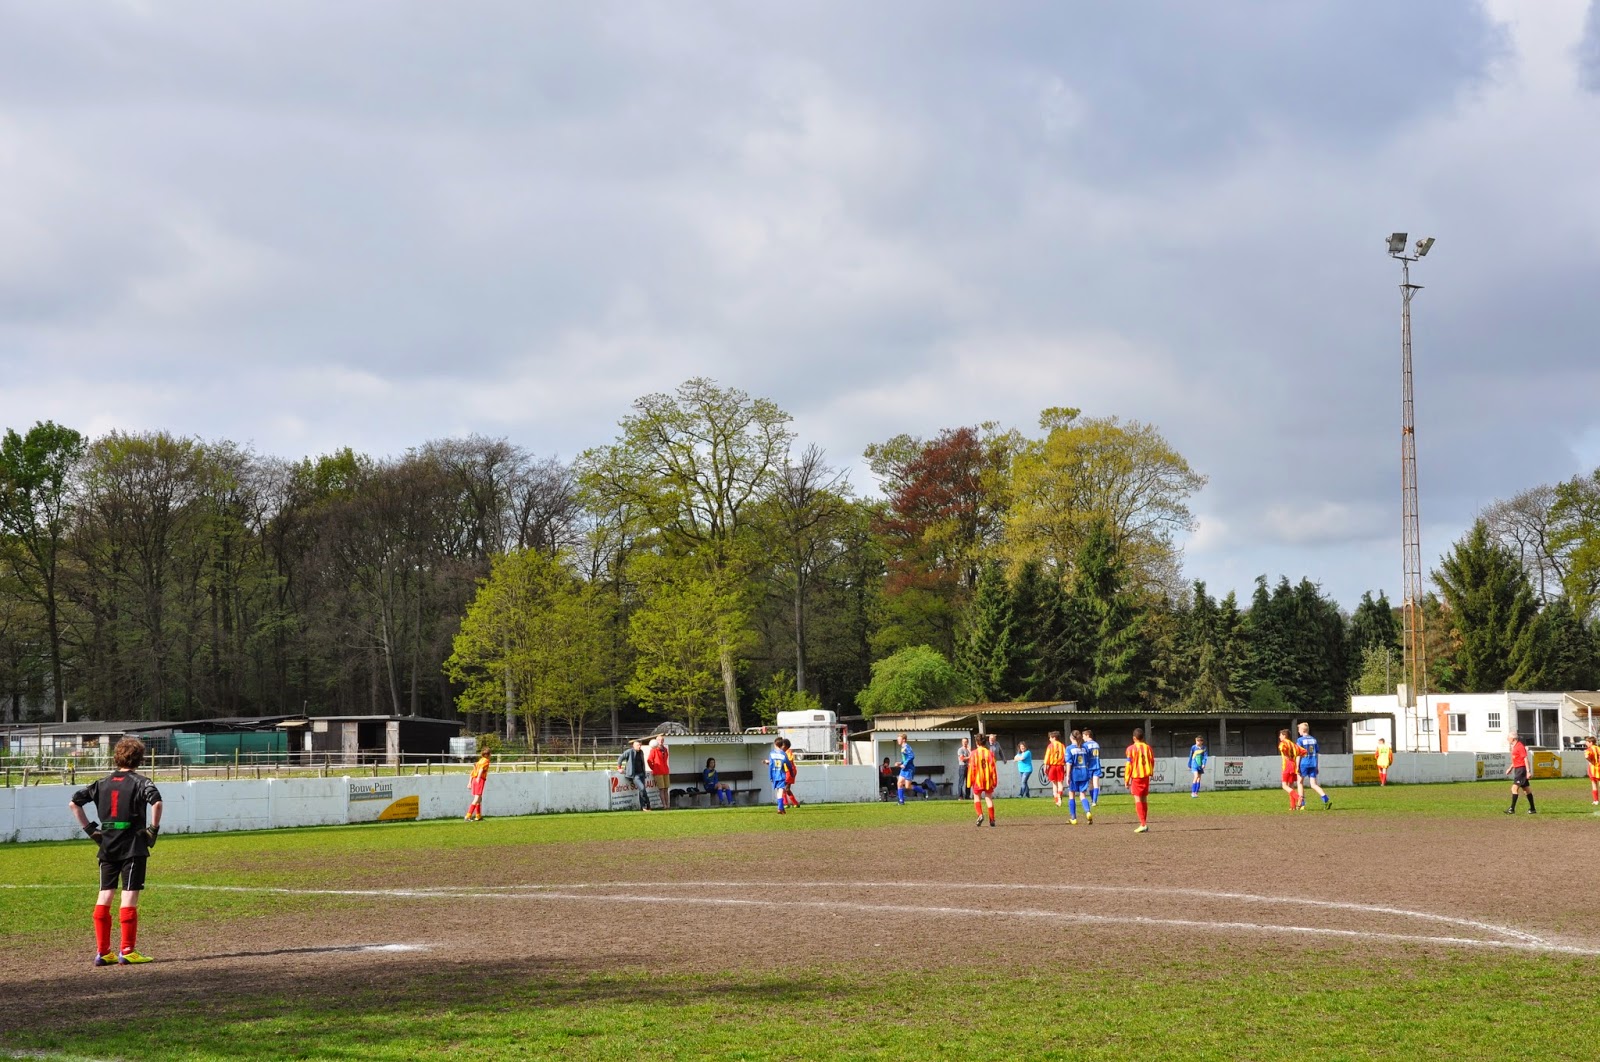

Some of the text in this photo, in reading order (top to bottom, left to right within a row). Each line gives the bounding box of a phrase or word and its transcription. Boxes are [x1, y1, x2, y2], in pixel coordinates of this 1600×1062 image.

[350, 782, 392, 793] Bouw Punt
[110, 790, 119, 818] 1
